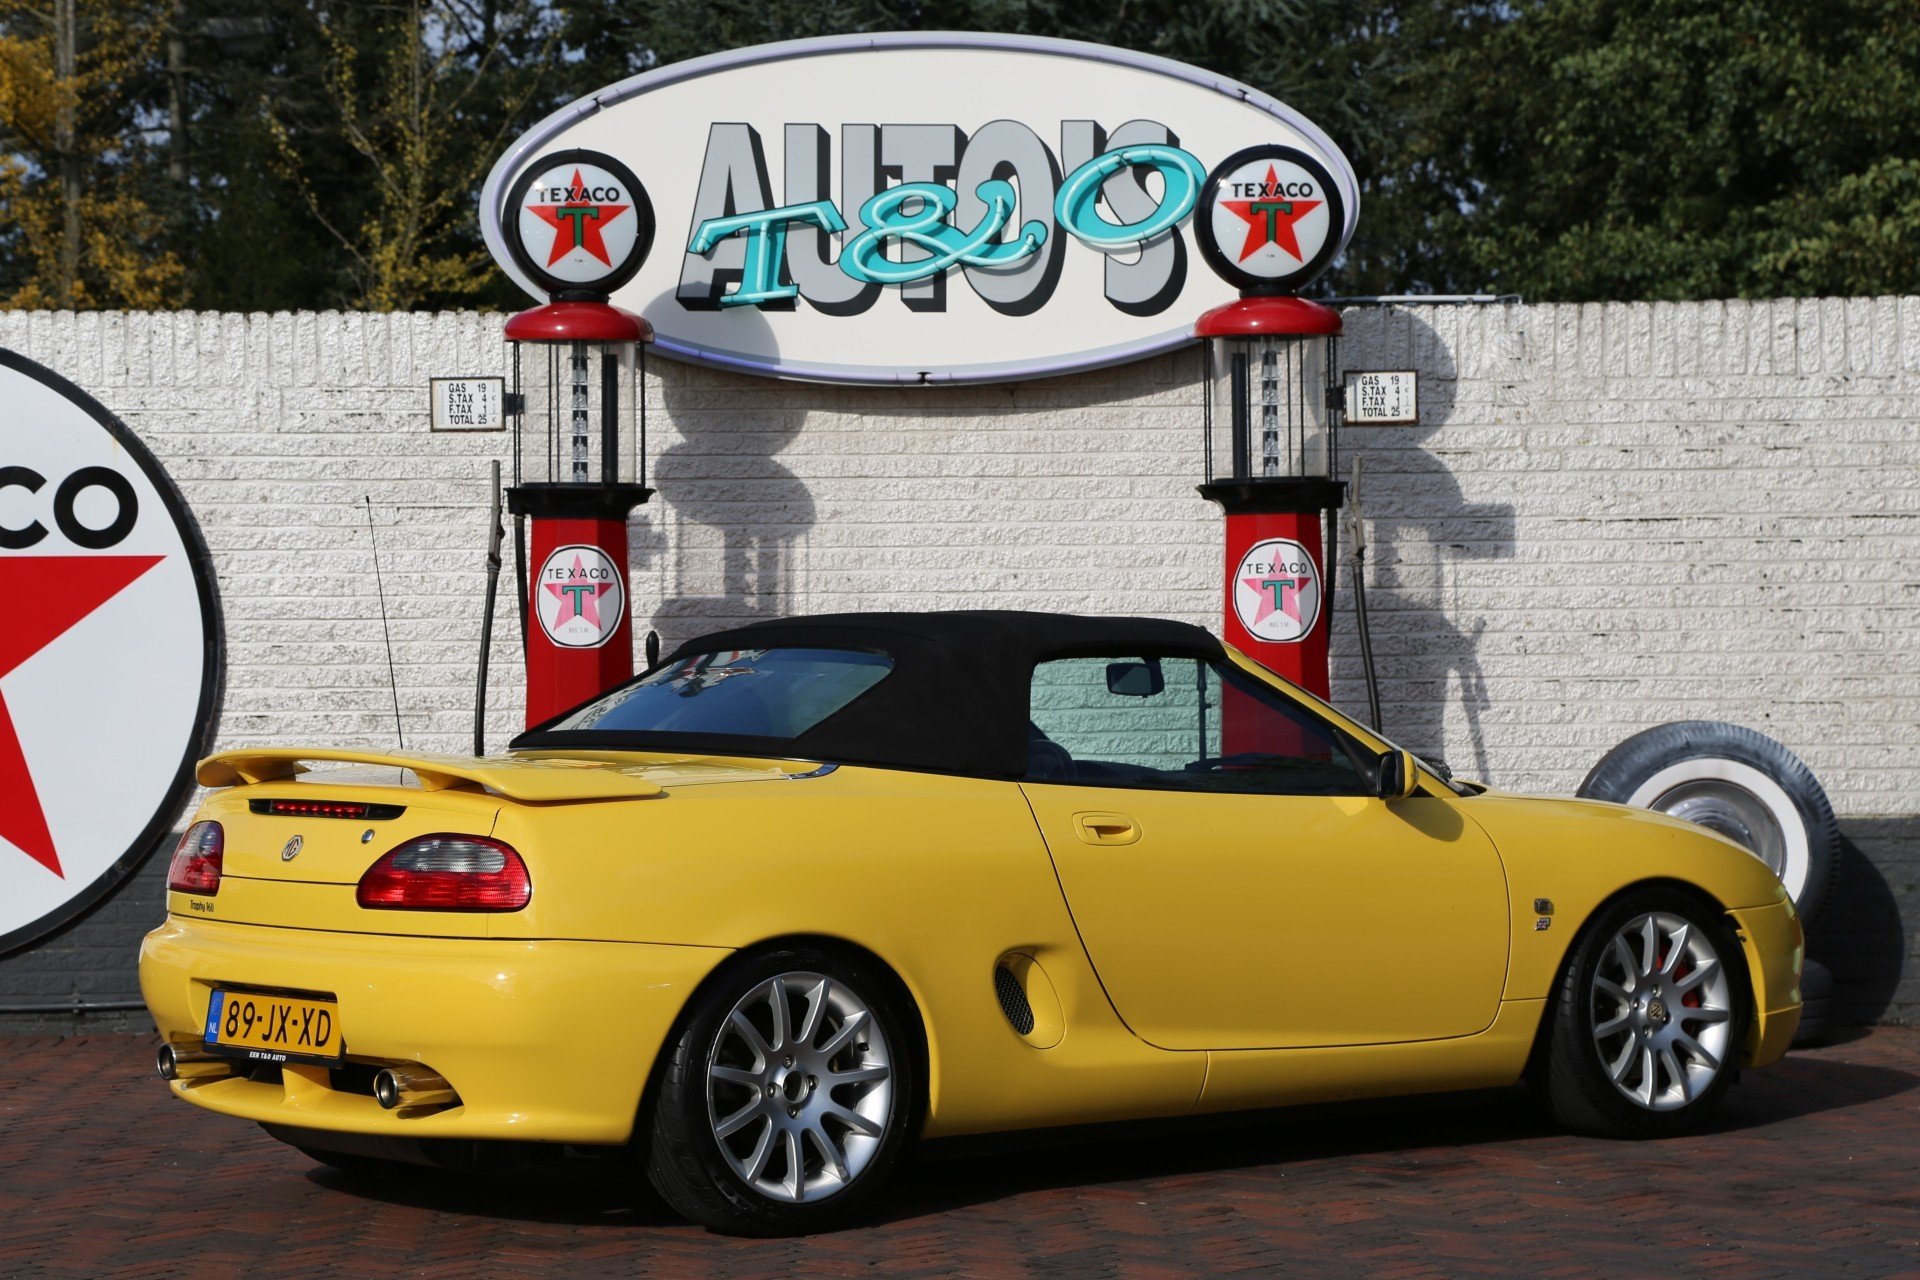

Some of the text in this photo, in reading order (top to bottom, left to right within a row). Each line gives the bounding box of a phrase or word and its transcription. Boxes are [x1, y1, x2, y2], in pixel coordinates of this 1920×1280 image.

[535, 187, 620, 202] TEXACO
[1231, 182, 1313, 198] TEXACO
[675, 119, 1188, 317] AUTO'S
[1361, 375, 1400, 386] GAS 19
[448, 382, 487, 393] GAS 19
[1361, 386, 1400, 396] S.TAX 4
[448, 393, 487, 404] S.TAX 4
[1362, 397, 1386, 406] F.TAX
[448, 404, 472, 414] F.TAX
[1362, 406, 1400, 417] TOTAL 25
[449, 414, 487, 425] TOTAL 25
[547, 568, 609, 579] TEXACO
[1246, 562, 1307, 574] TEXACO
[190, 899, 205, 912] Trophy
[208, 1021, 218, 1034] NL
[225, 1000, 331, 1047] 89-JX-XD
[260, 1052, 271, 1060] T&O
[271, 1053, 287, 1062] AUTO
